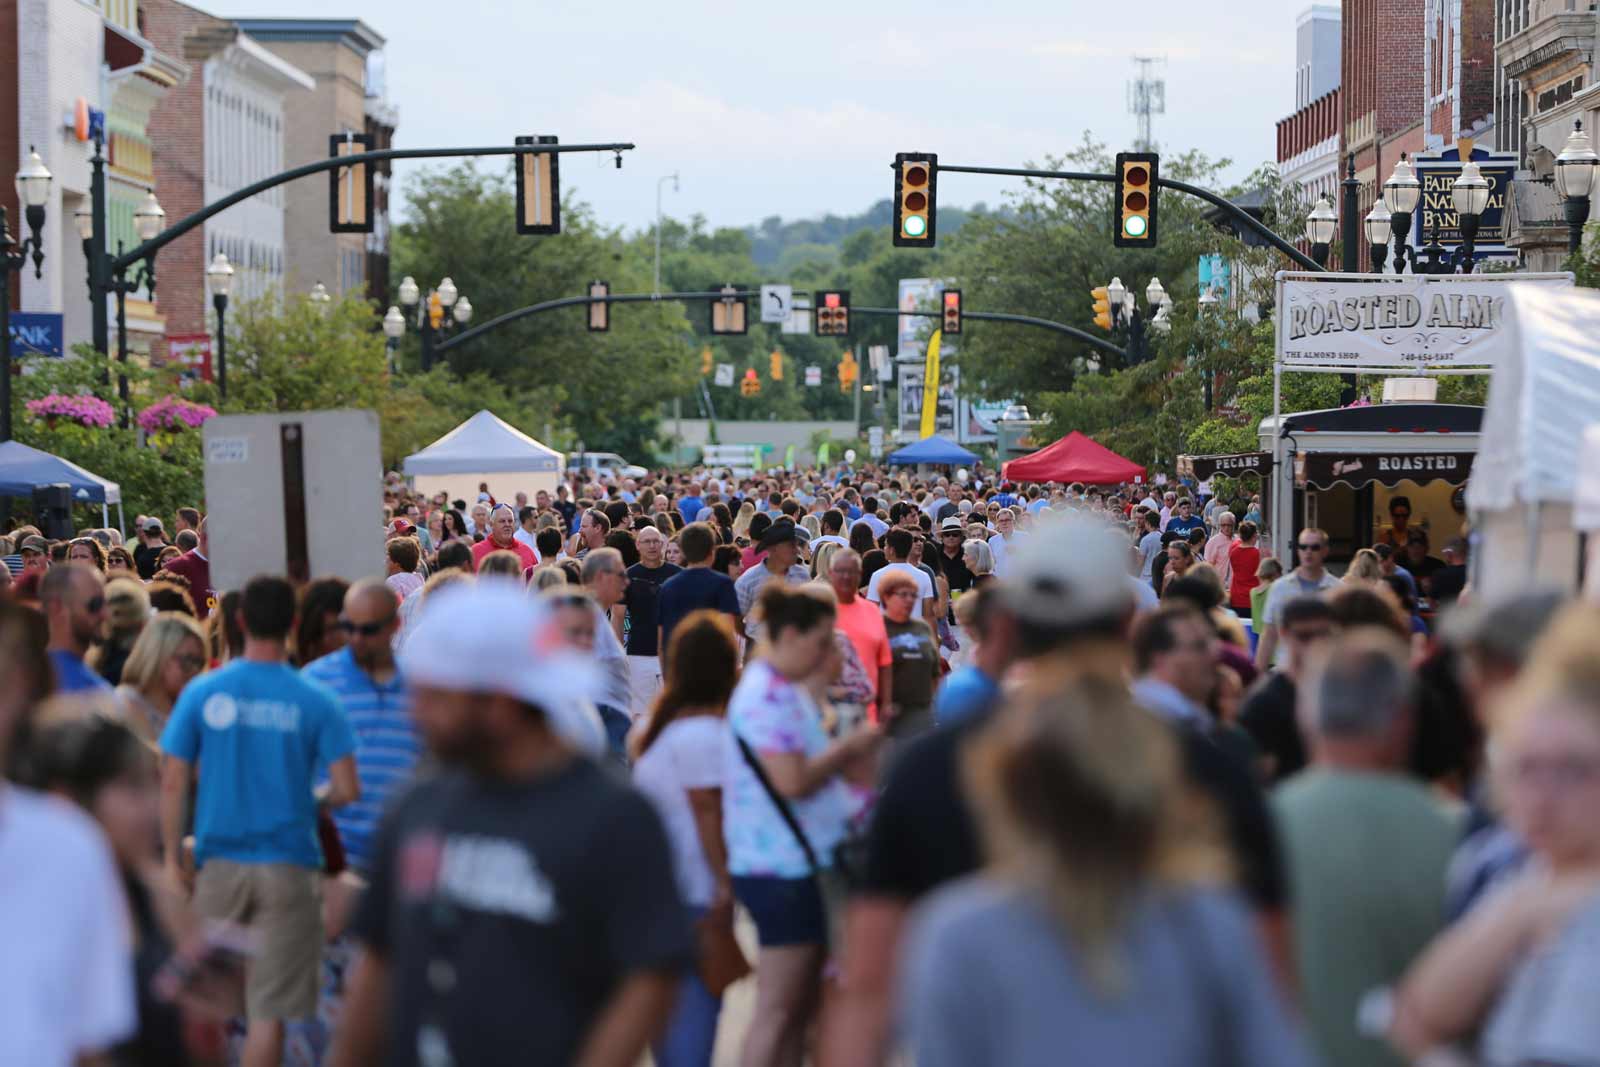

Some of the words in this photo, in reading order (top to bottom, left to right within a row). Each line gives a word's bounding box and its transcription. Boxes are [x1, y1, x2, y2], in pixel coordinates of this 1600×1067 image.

[1423, 175, 1497, 192] FAIRD
[1423, 193, 1505, 209] NATAL
[1290, 294, 1421, 340] ROASTED
[1285, 351, 1301, 359] THE
[1303, 351, 1336, 359] ALMOND
[1338, 352, 1360, 360] SHOP
[1216, 456, 1259, 469] PECANS
[1378, 455, 1457, 470] ROASTED
